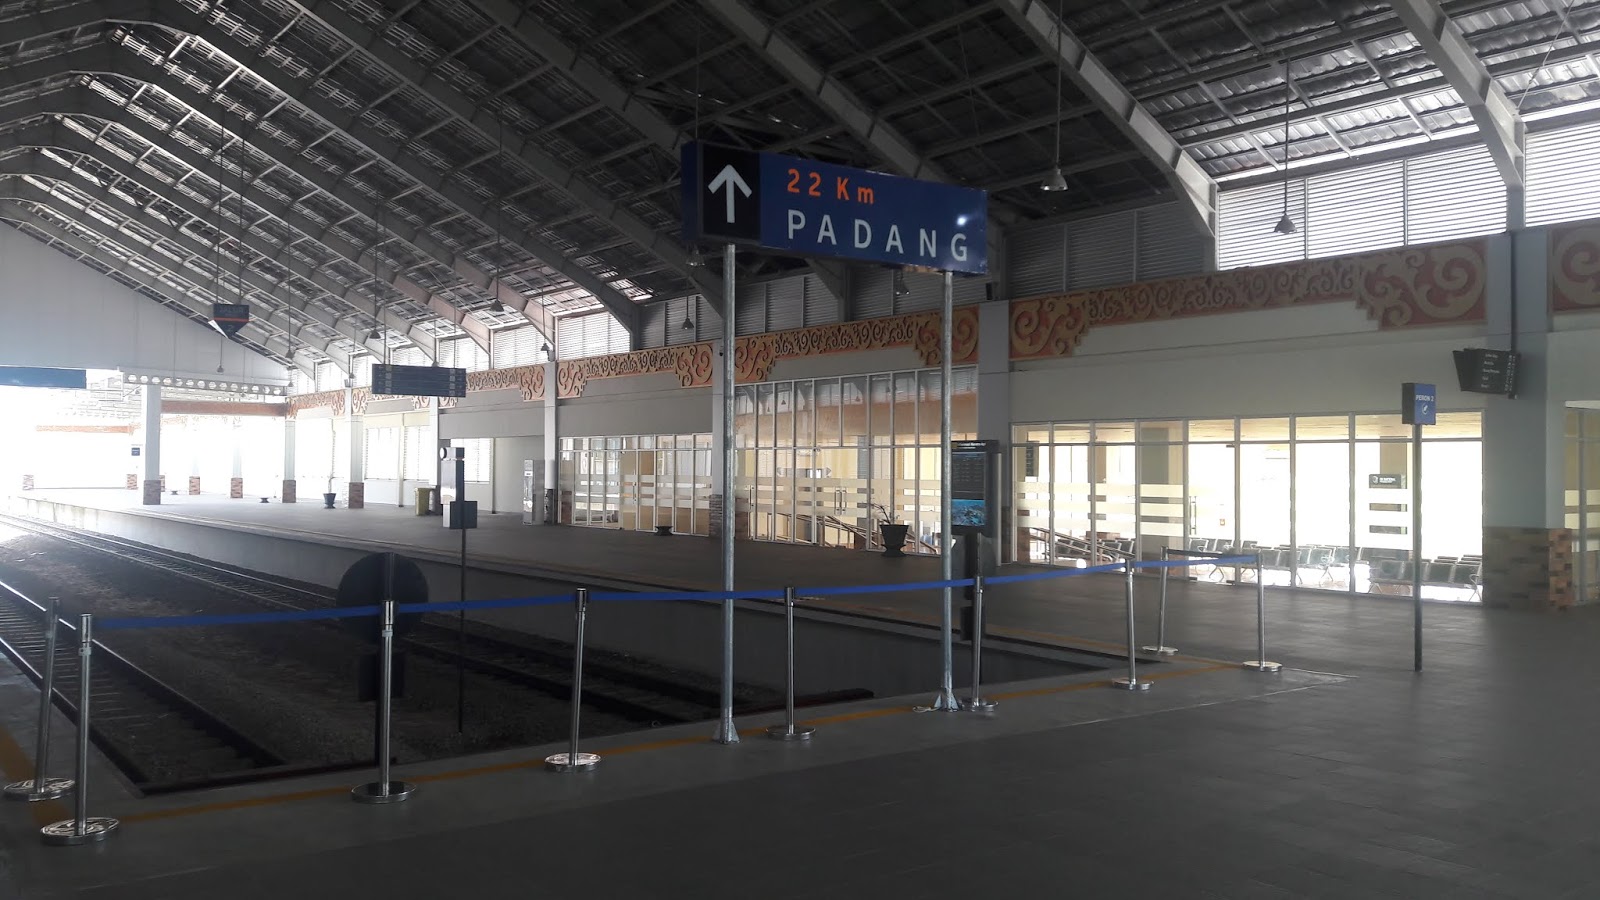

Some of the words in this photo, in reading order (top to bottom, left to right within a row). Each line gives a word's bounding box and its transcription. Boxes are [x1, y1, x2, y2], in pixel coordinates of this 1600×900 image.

[787, 168, 821, 197] 22
[836, 176, 874, 204] Km
[787, 208, 968, 262] PADANG
[1415, 394, 1430, 402] PERON
